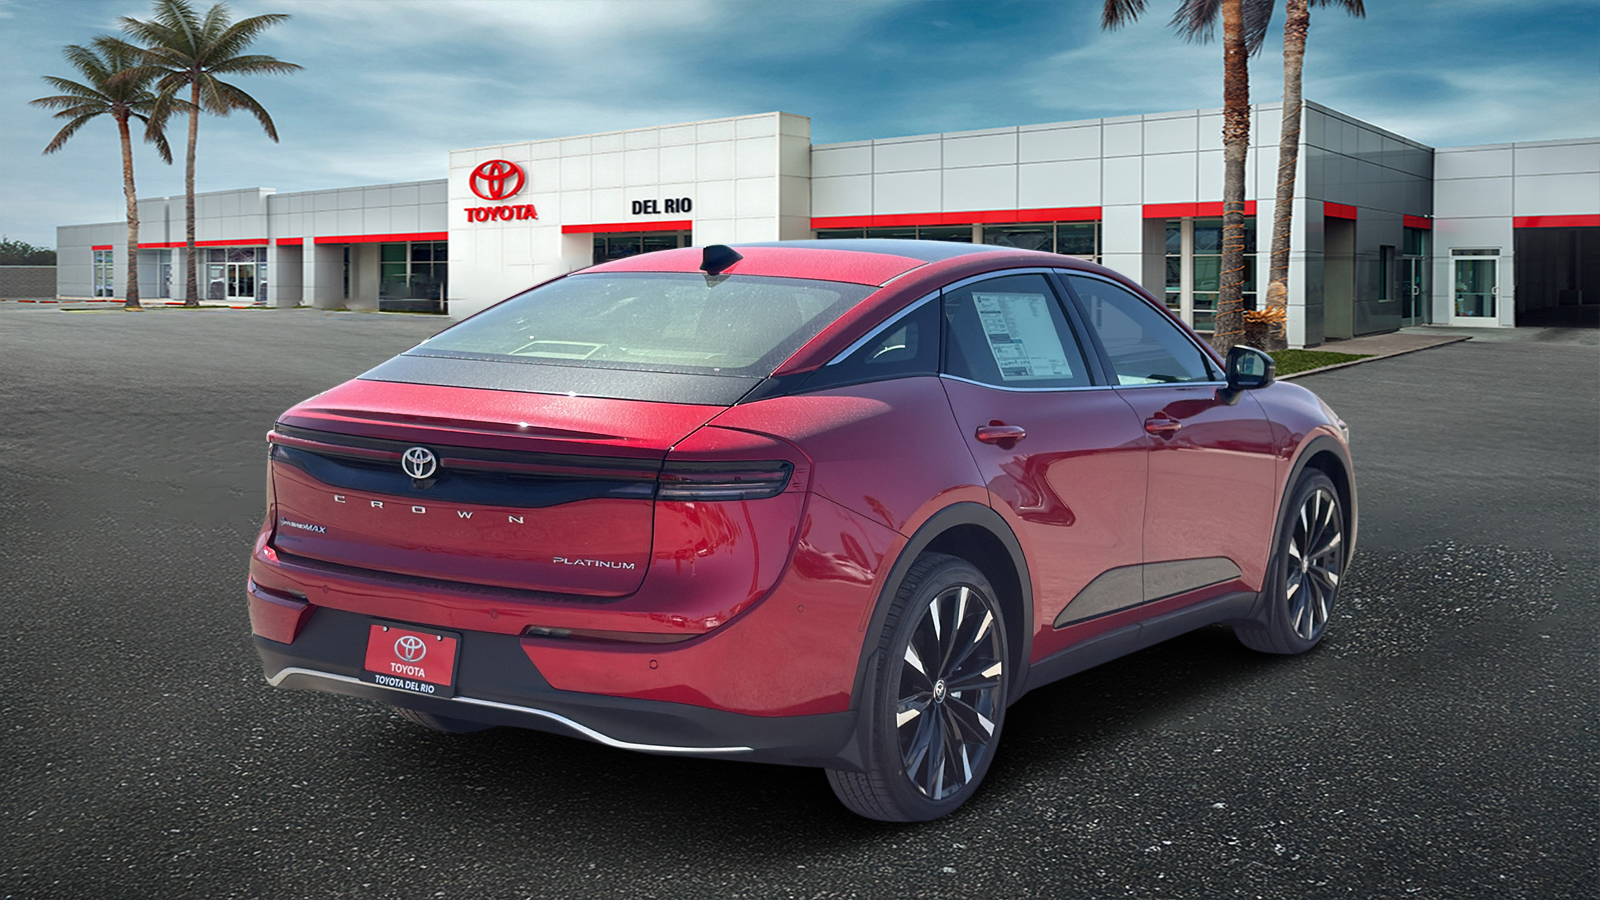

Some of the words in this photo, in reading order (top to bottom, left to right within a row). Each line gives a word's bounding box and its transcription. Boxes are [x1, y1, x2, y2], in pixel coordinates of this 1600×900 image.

[464, 204, 538, 222] TOYOTA
[632, 200, 661, 215] DEL
[665, 197, 692, 213] RIO
[334, 494, 524, 524] CROWN
[553, 556, 635, 570] PLATINUM
[390, 662, 425, 678] TOYOTA
[375, 675, 404, 688] TOYOTA
[405, 680, 419, 691] DEL
[420, 683, 435, 694] RIO
